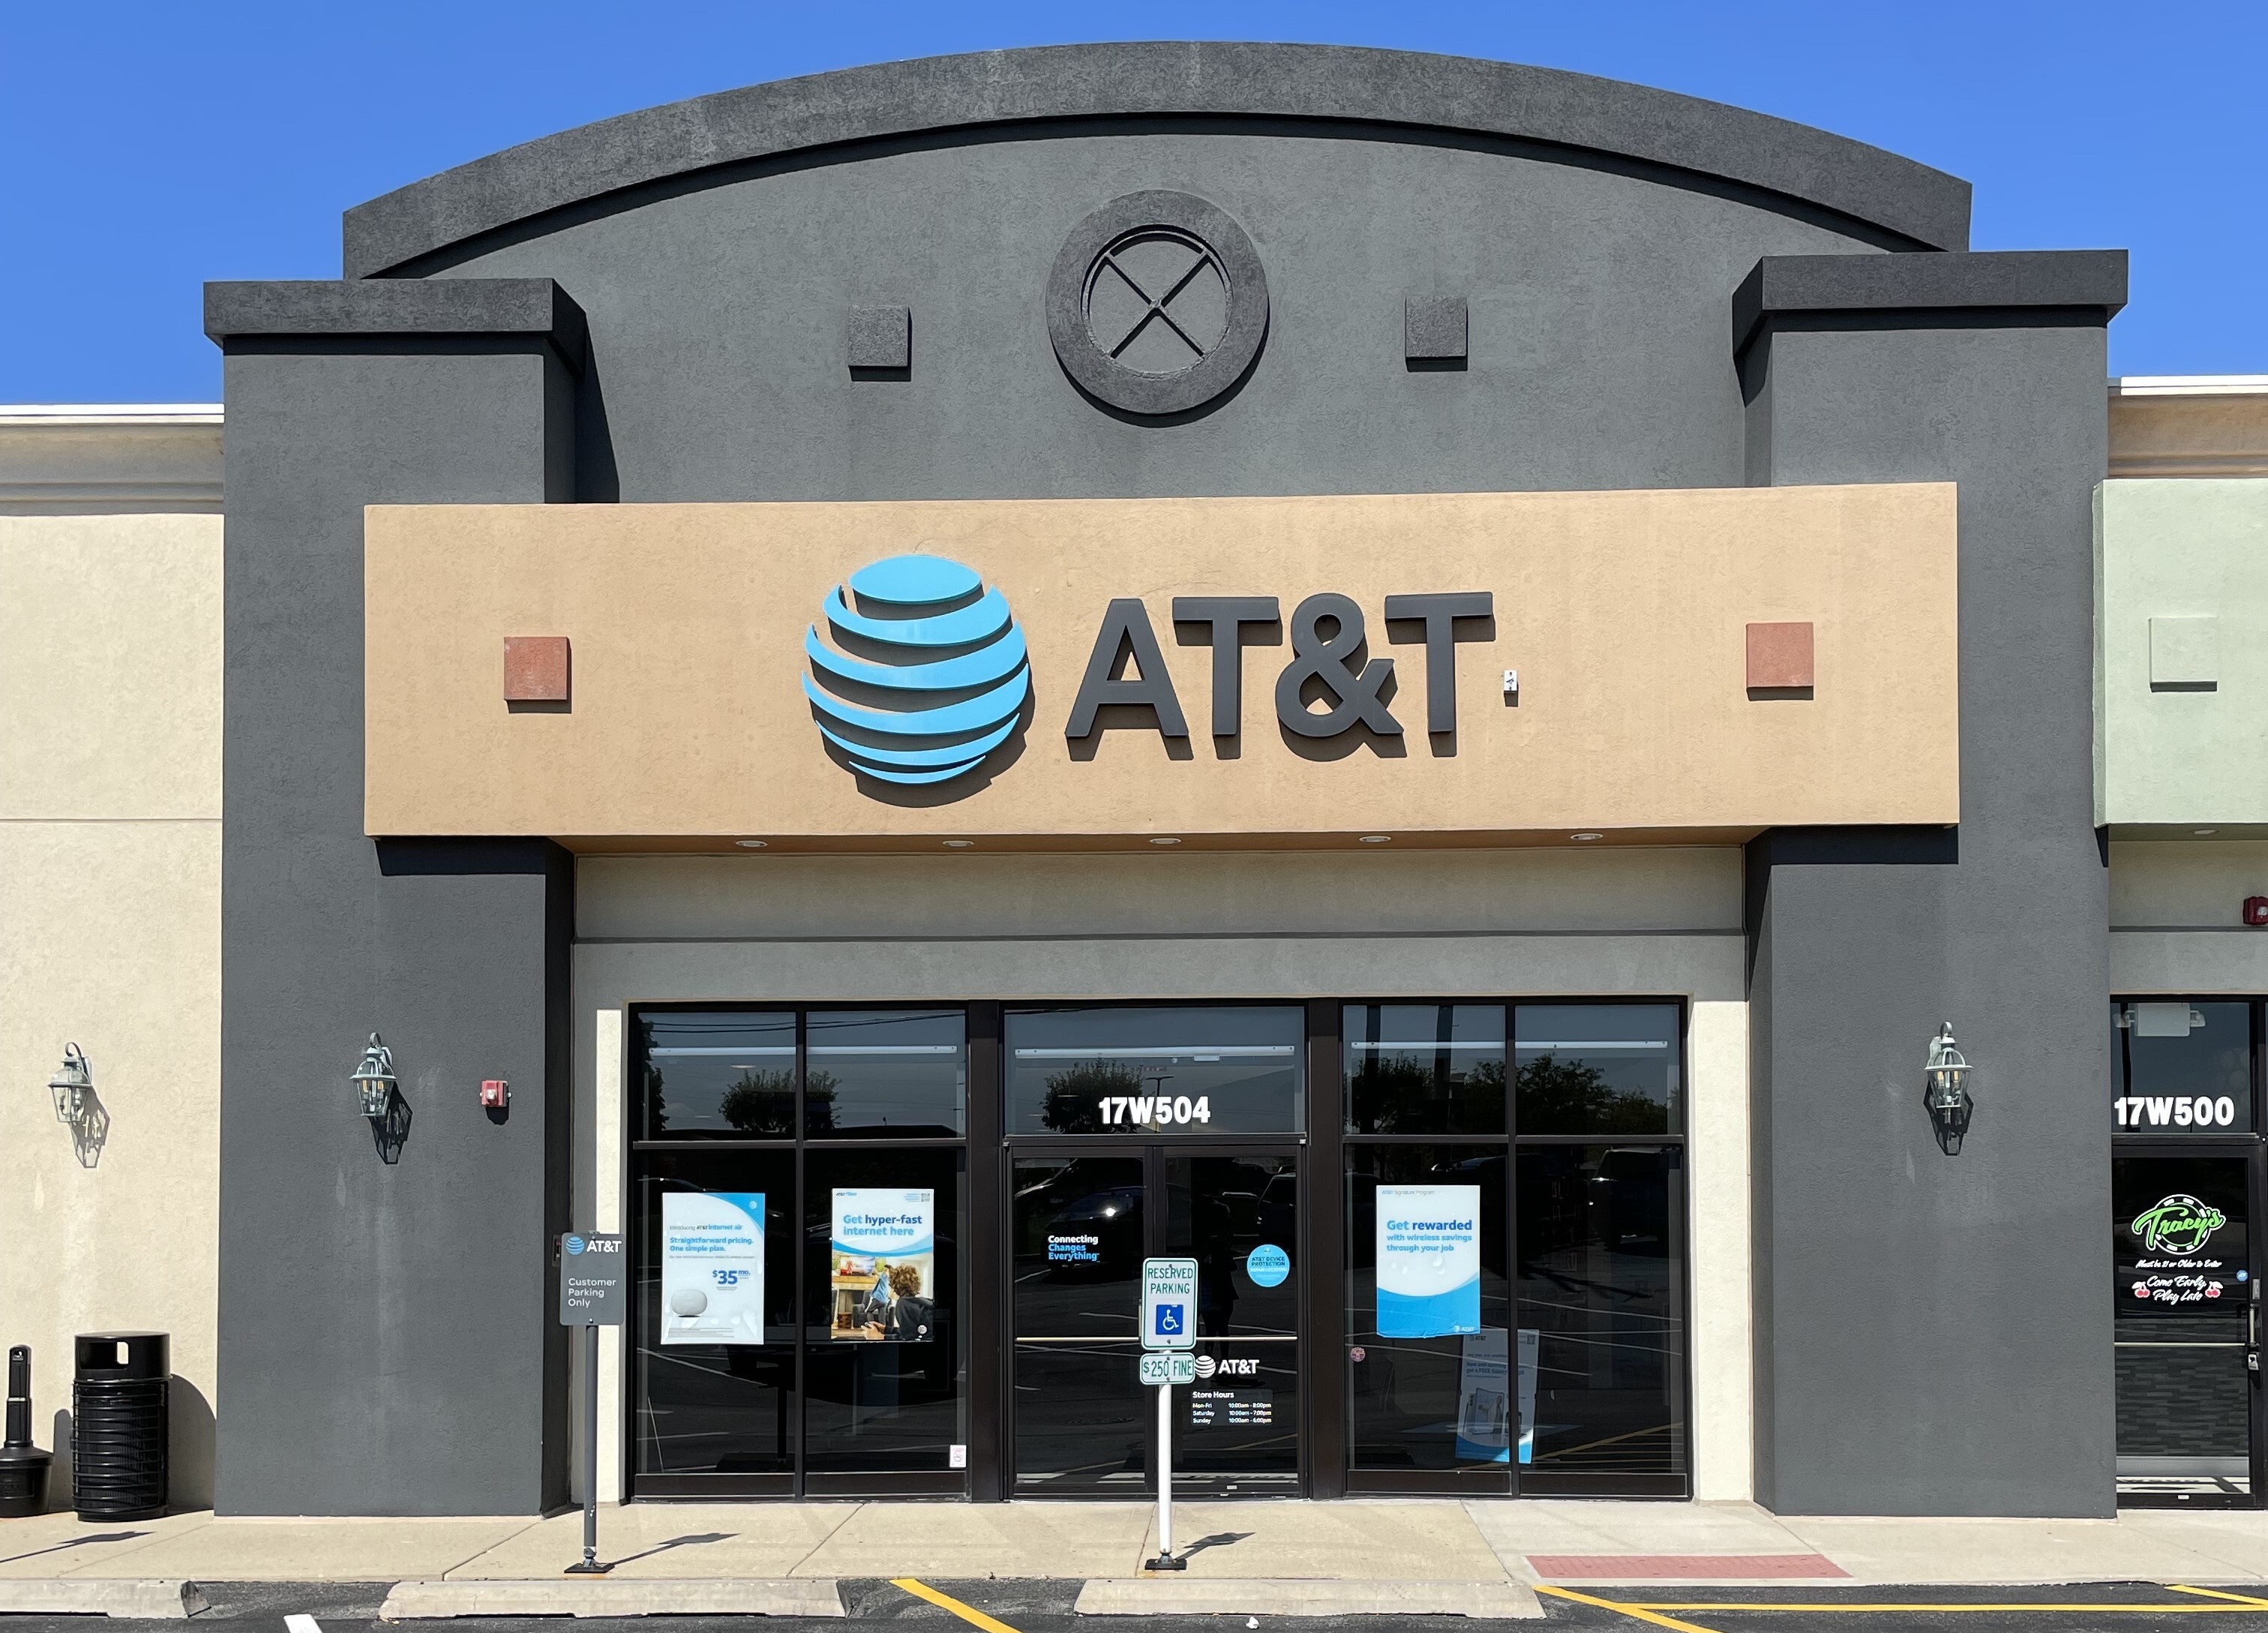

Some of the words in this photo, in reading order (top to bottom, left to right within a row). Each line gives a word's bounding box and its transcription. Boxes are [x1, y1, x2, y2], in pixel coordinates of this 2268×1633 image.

[1065, 592, 1492, 738] AT&T
[1099, 1096, 1211, 1124] 17W504
[2114, 1096, 2235, 1126] 17W500
[843, 1214, 863, 1224] Get
[865, 1214, 922, 1226] hyper-fast
[1387, 1220, 1409, 1231] Get
[1412, 1220, 1472, 1231] rewarded
[843, 1226, 888, 1236] internet
[890, 1226, 914, 1235] here
[2134, 1206, 2223, 1247] Tracy's
[728, 1237, 754, 1245] pricing.
[1048, 1234, 1099, 1245] Connecting
[1442, 1234, 1472, 1243] savings
[586, 1240, 622, 1253] AT&T
[1048, 1244, 1086, 1253] Changes
[1387, 1244, 1419, 1253] through
[1440, 1244, 1454, 1253] job
[1148, 1267, 1193, 1280] RESERVED
[568, 1277, 616, 1286] Customer
[2146, 1275, 2174, 1287] Come
[2174, 1274, 2207, 1291] Early
[568, 1288, 604, 1298] Parking
[1150, 1283, 1190, 1295] PARKING
[568, 1298, 591, 1308] Only
[2152, 1289, 2180, 1305] Play
[2180, 1289, 2204, 1301] Late
[1143, 1361, 1170, 1377] $250
[1173, 1359, 1193, 1376] FINE
[1218, 1359, 1260, 1374] AT&T
